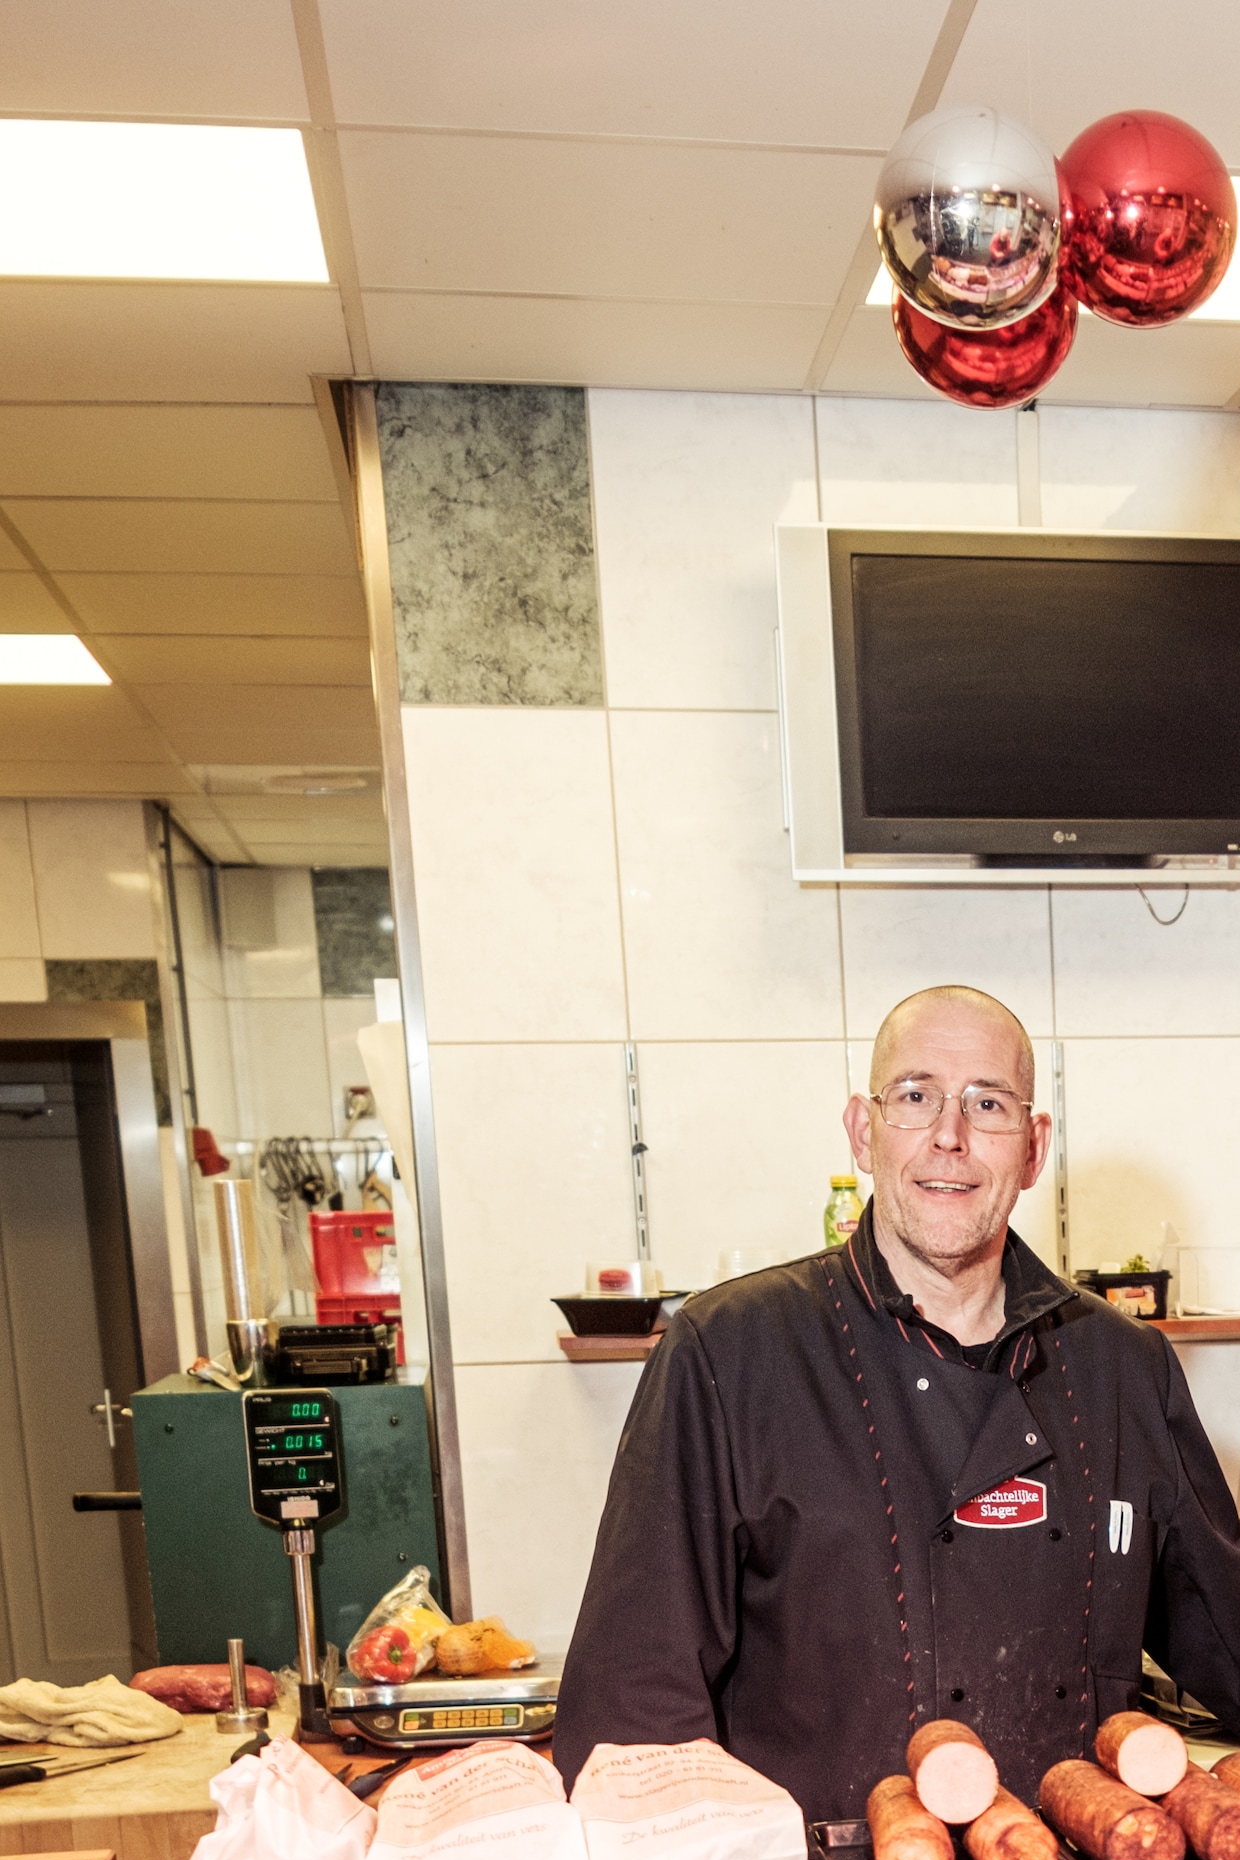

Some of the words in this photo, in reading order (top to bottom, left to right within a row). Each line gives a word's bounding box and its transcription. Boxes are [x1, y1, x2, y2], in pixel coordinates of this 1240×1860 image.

[292, 1403, 320, 1417] 0.00
[285, 1434, 323, 1449] 0.015
[968, 1489, 1039, 1505] bachtelijke
[980, 1504, 1018, 1519] Slager
[636, 1750, 668, 1762] van
[673, 1746, 704, 1755] der
[431, 1777, 459, 1796] van
[463, 1762, 488, 1778] der
[652, 1813, 708, 1837] kwaliteit
